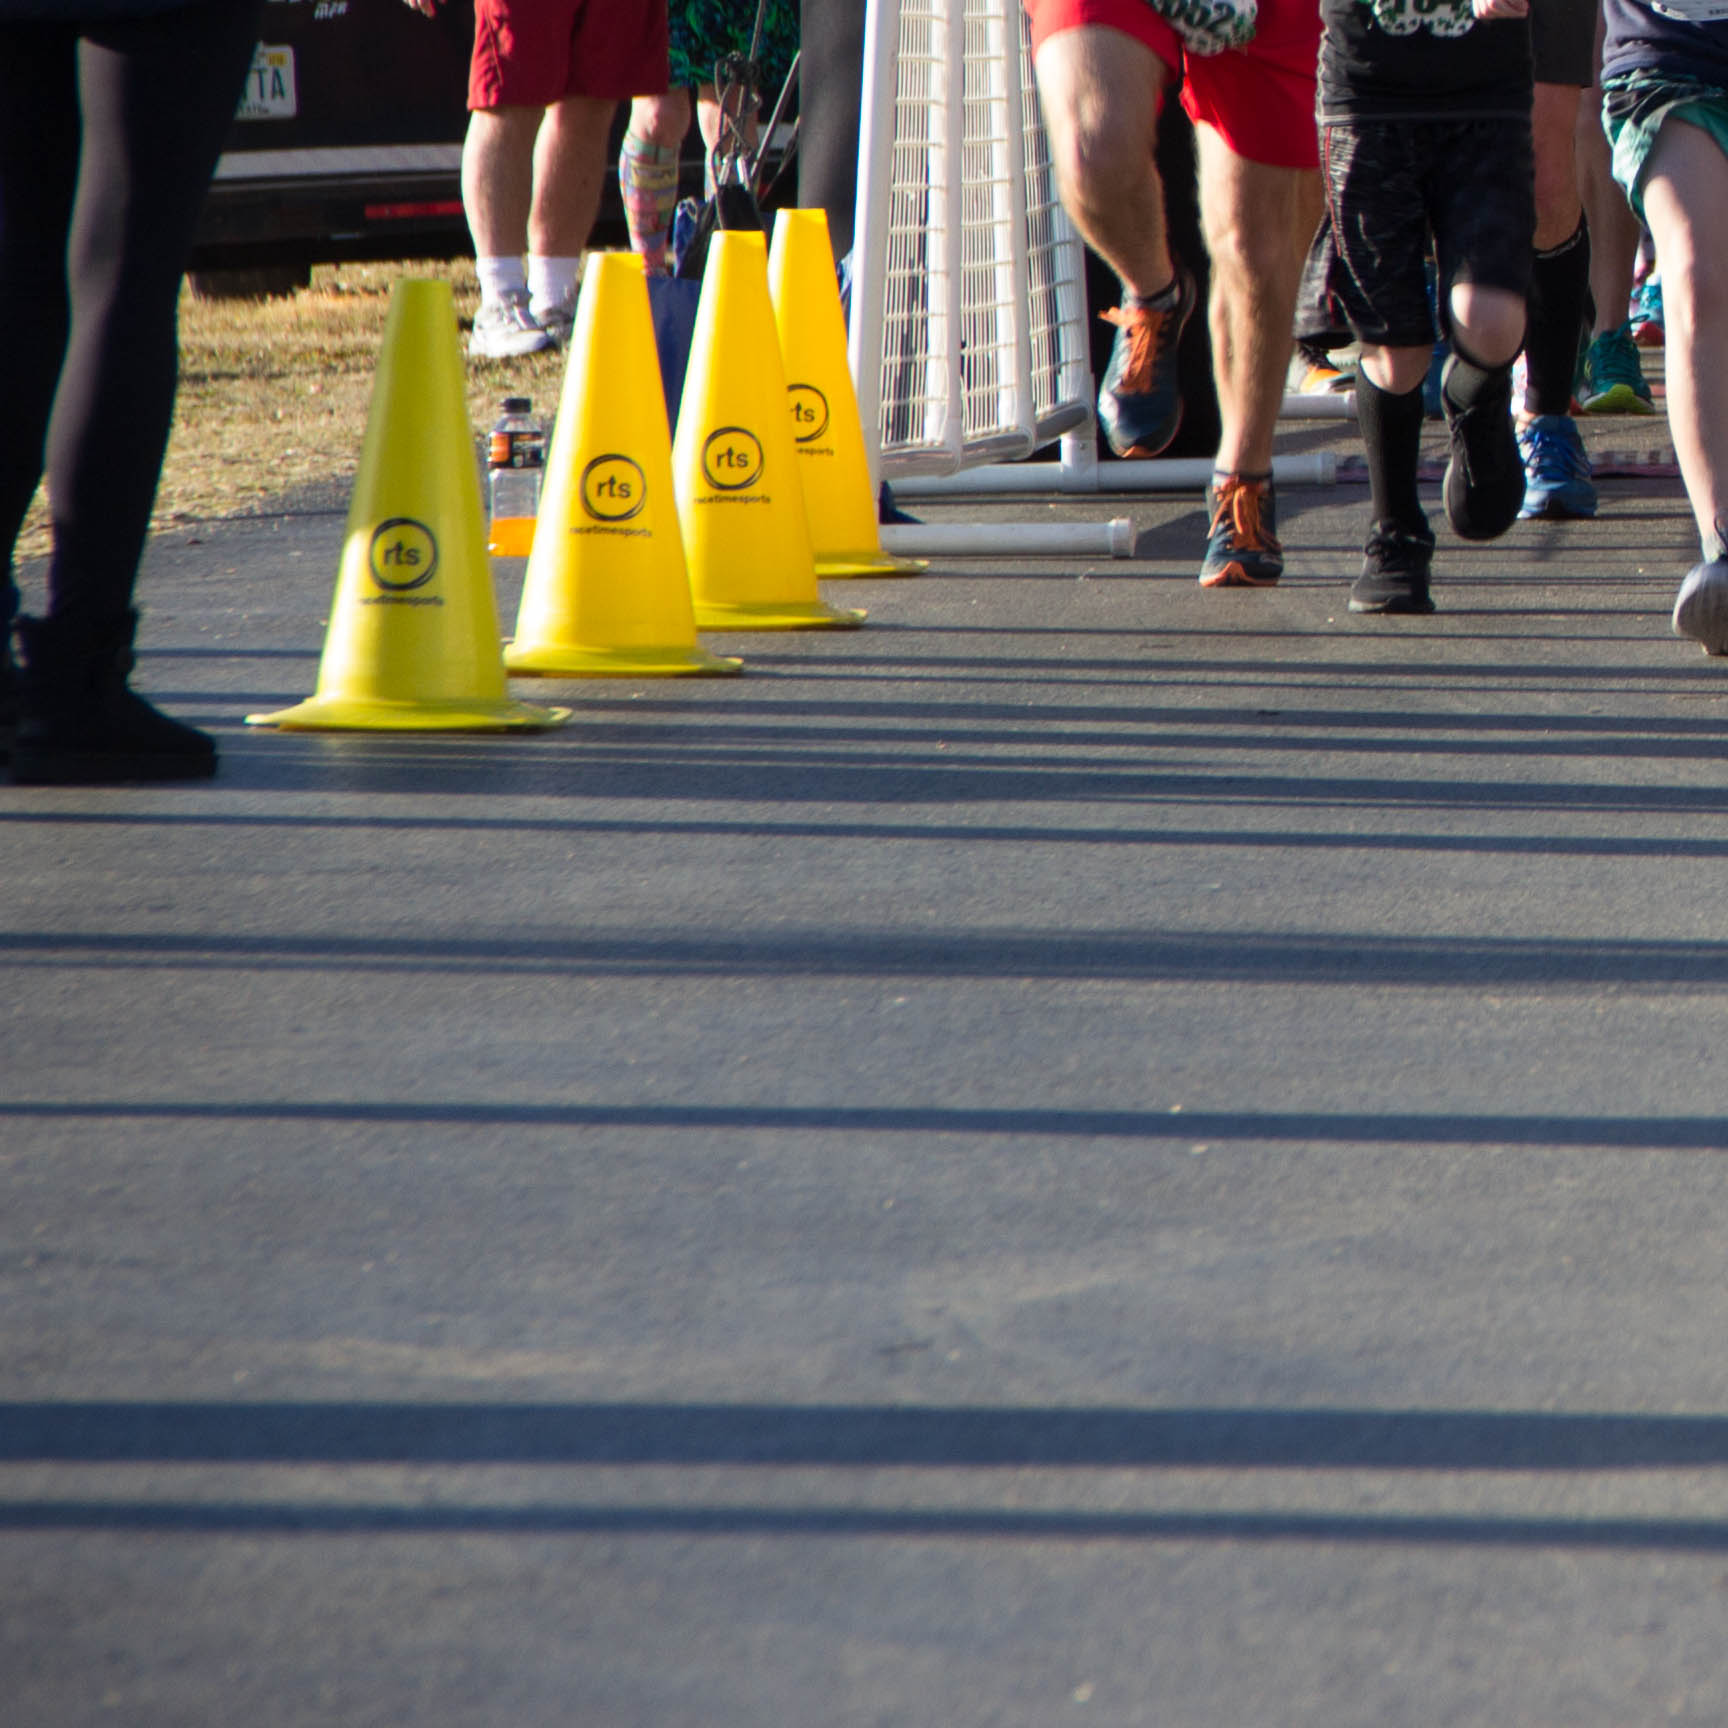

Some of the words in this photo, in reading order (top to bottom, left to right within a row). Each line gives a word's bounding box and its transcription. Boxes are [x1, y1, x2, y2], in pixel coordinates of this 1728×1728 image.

[716, 446, 749, 469] rts
[596, 474, 631, 499] rts
[383, 541, 420, 566] rts
